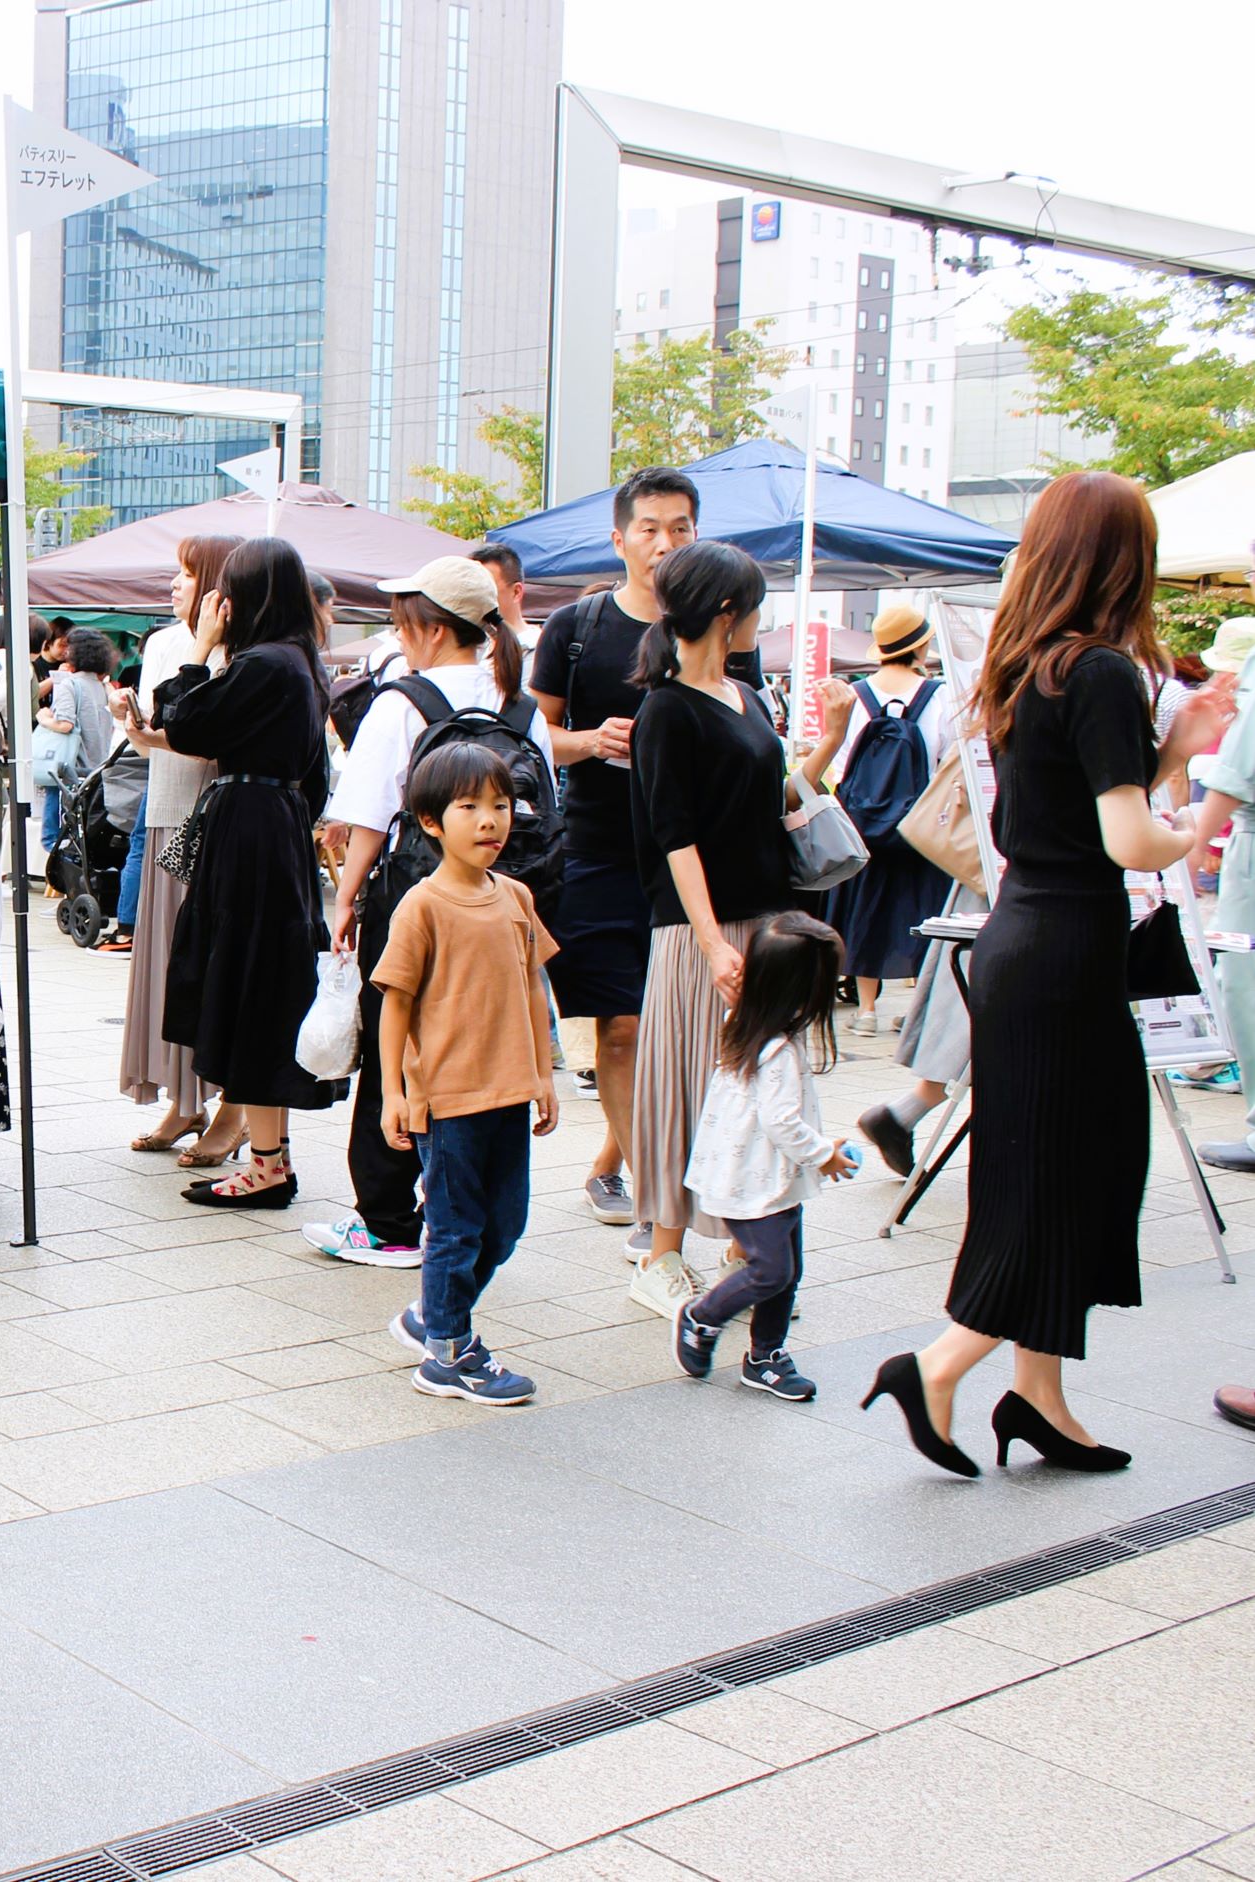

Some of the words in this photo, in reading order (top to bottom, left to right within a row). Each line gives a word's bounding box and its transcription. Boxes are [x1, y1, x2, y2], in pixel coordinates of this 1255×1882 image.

[19, 145, 76, 164] パティスリー
[20, 170, 96, 191] エフテレット
